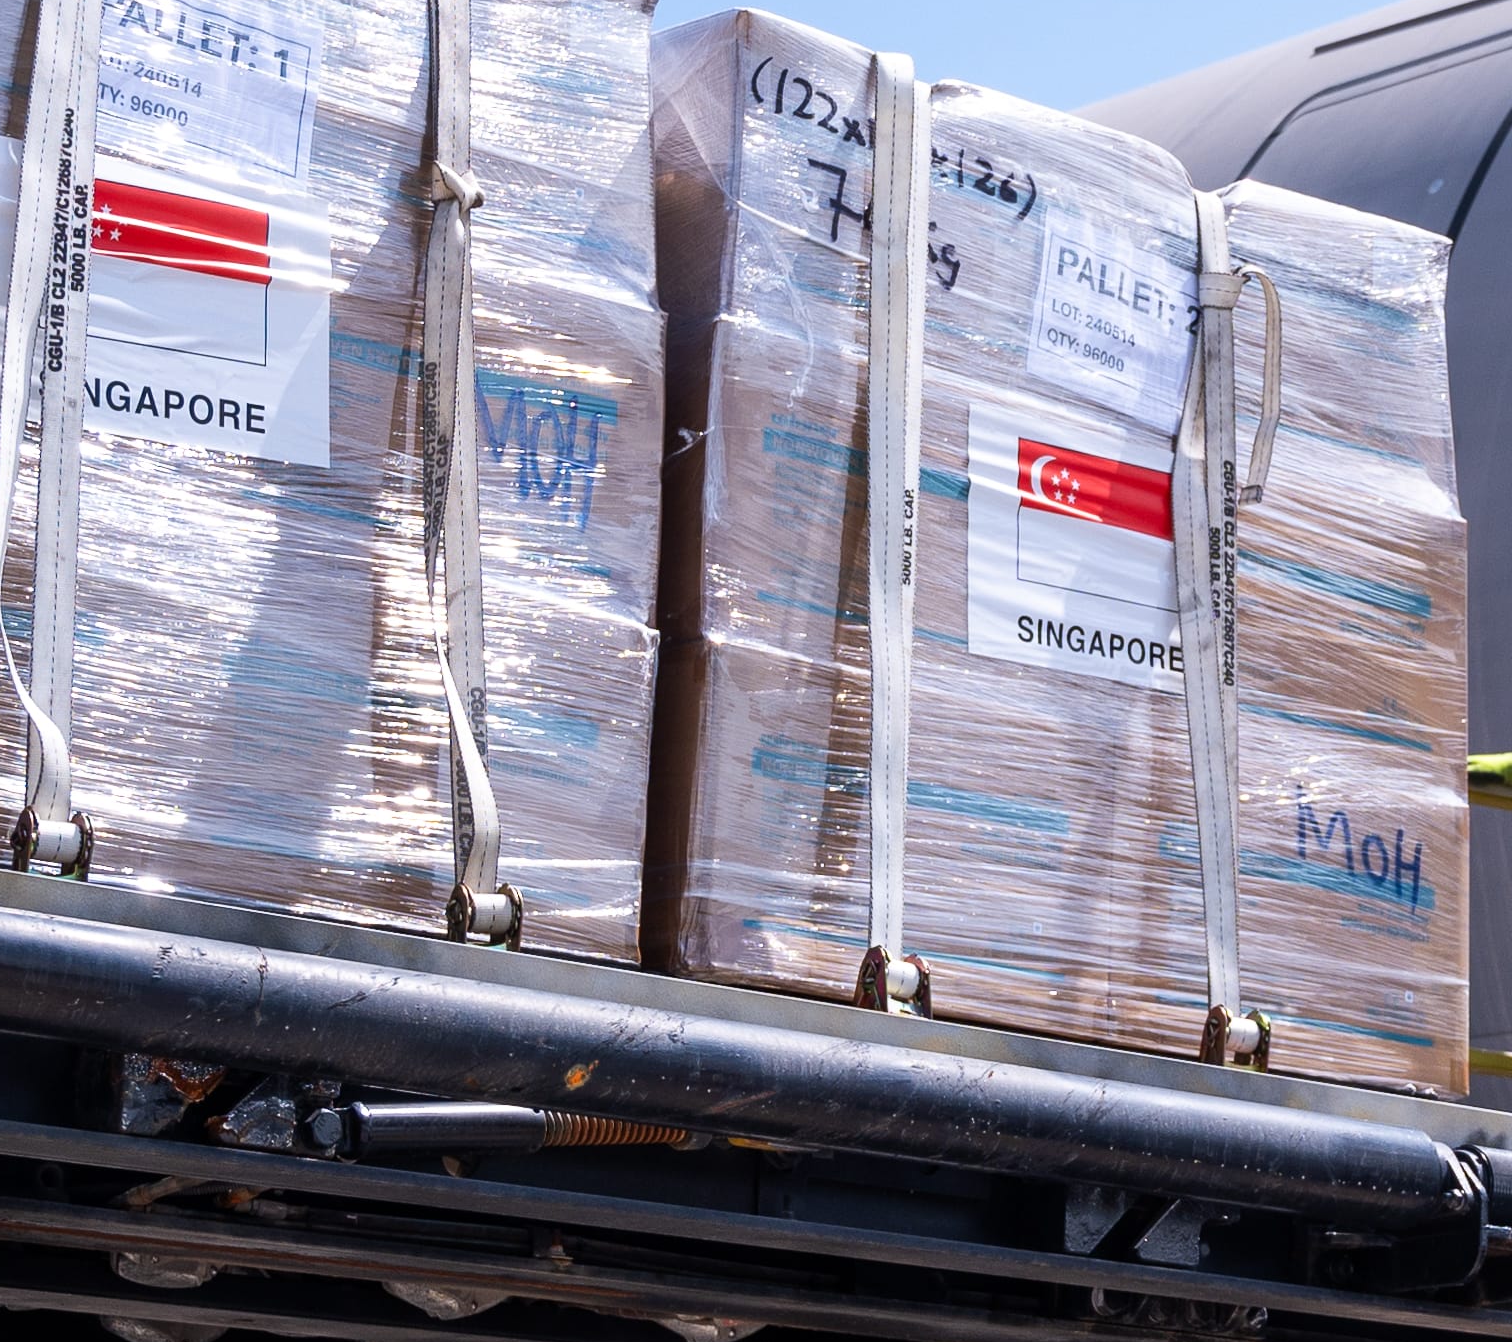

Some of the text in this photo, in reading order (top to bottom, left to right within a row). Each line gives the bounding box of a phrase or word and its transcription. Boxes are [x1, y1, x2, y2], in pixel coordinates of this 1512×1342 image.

[273, 49, 289, 82] 1
[97, 81, 189, 127] TY: 96000
[69, 185, 89, 293] 5000 LB. CAP.
[50, 263, 67, 301] CL2
[1057, 245, 1201, 336] PALLET: 2
[47, 303, 66, 373] CGU-1/B
[1051, 298, 1136, 348] LOT: 240514
[1047, 328, 1125, 372] QTY: 96000
[84, 377, 266, 434] NGAPORE
[904, 488, 915, 520] CAP.
[1223, 460, 1235, 521] CGU-1/B
[1224, 522, 1235, 549] CL2
[1017, 615, 1185, 673] SINGAPORE
[1295, 784, 1423, 915] MOH
